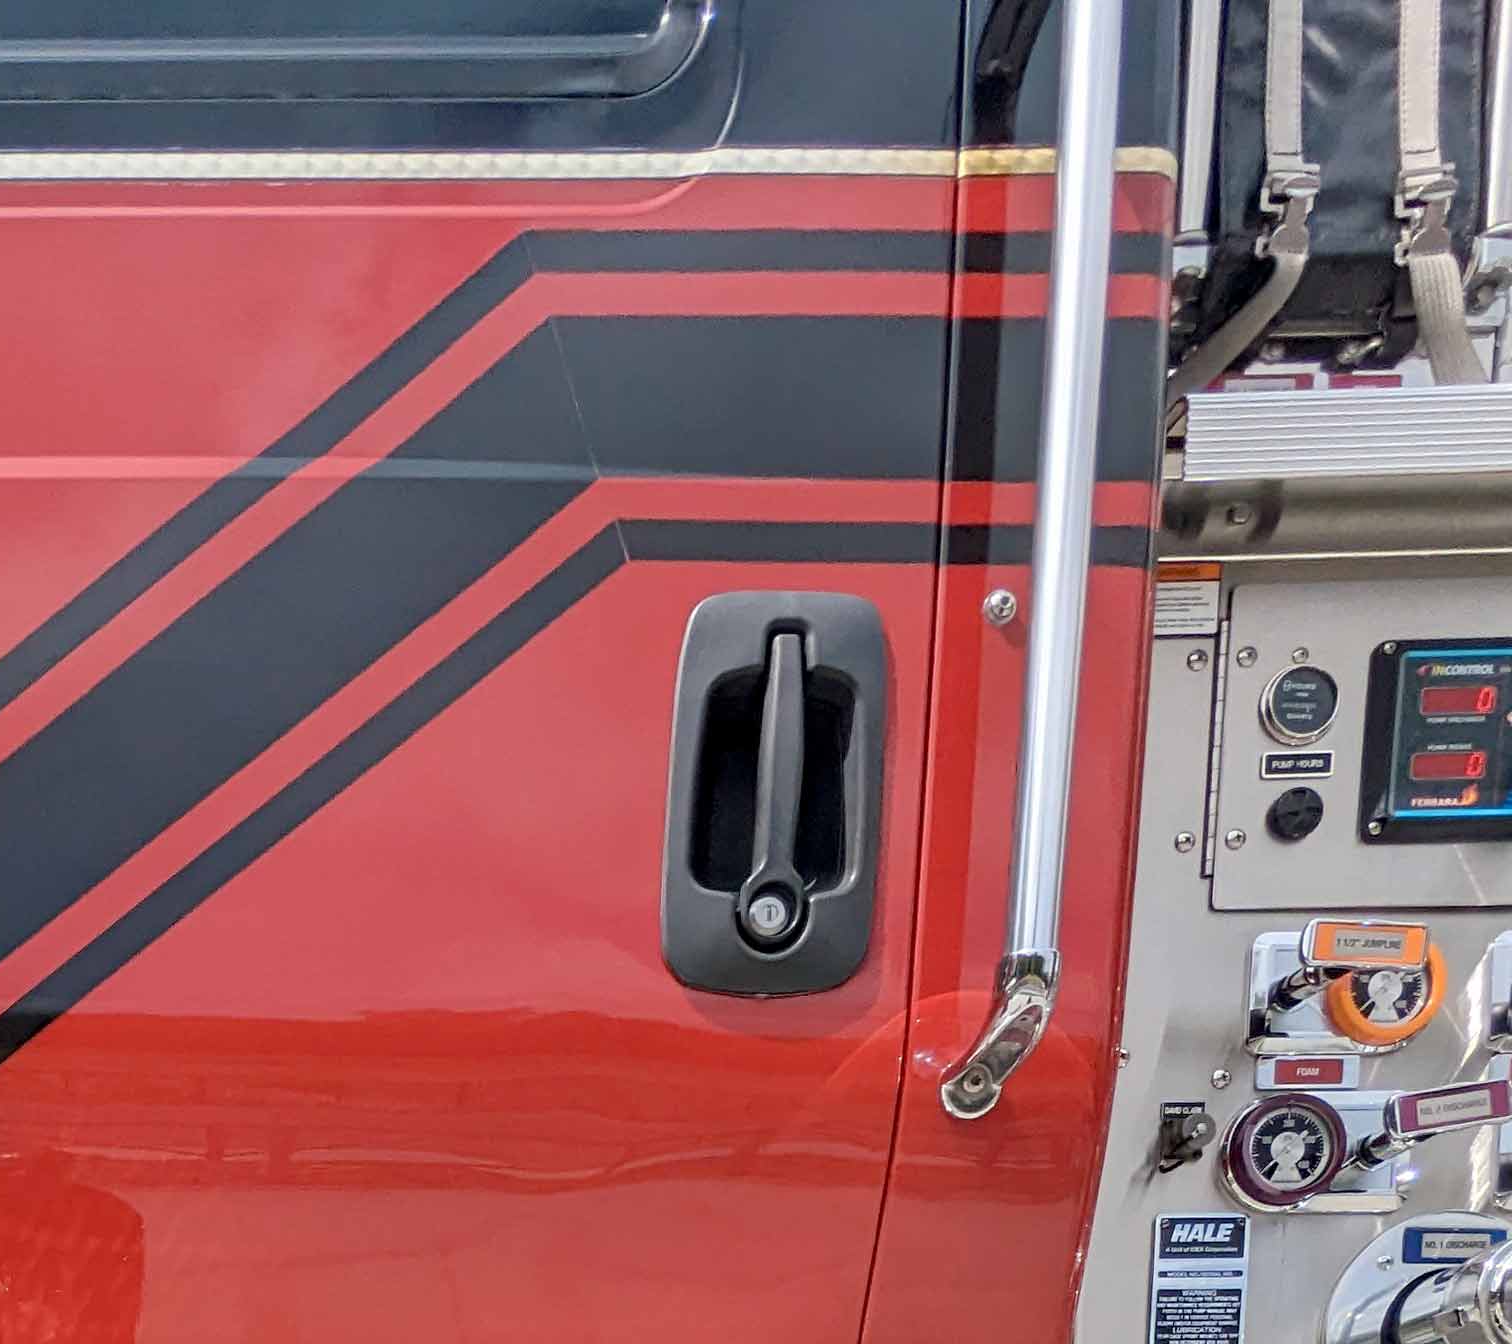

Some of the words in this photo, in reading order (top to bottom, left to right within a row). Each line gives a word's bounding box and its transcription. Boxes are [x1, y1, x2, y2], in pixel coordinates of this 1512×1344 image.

[1476, 687, 1493, 713] 0
[1272, 760, 1295, 769] PUMP
[1296, 759, 1324, 768] HOURS
[1296, 1067, 1320, 1077] FOAM
[1170, 1223, 1235, 1243] HALE
[1445, 1240, 1488, 1249] DISCHARGE
